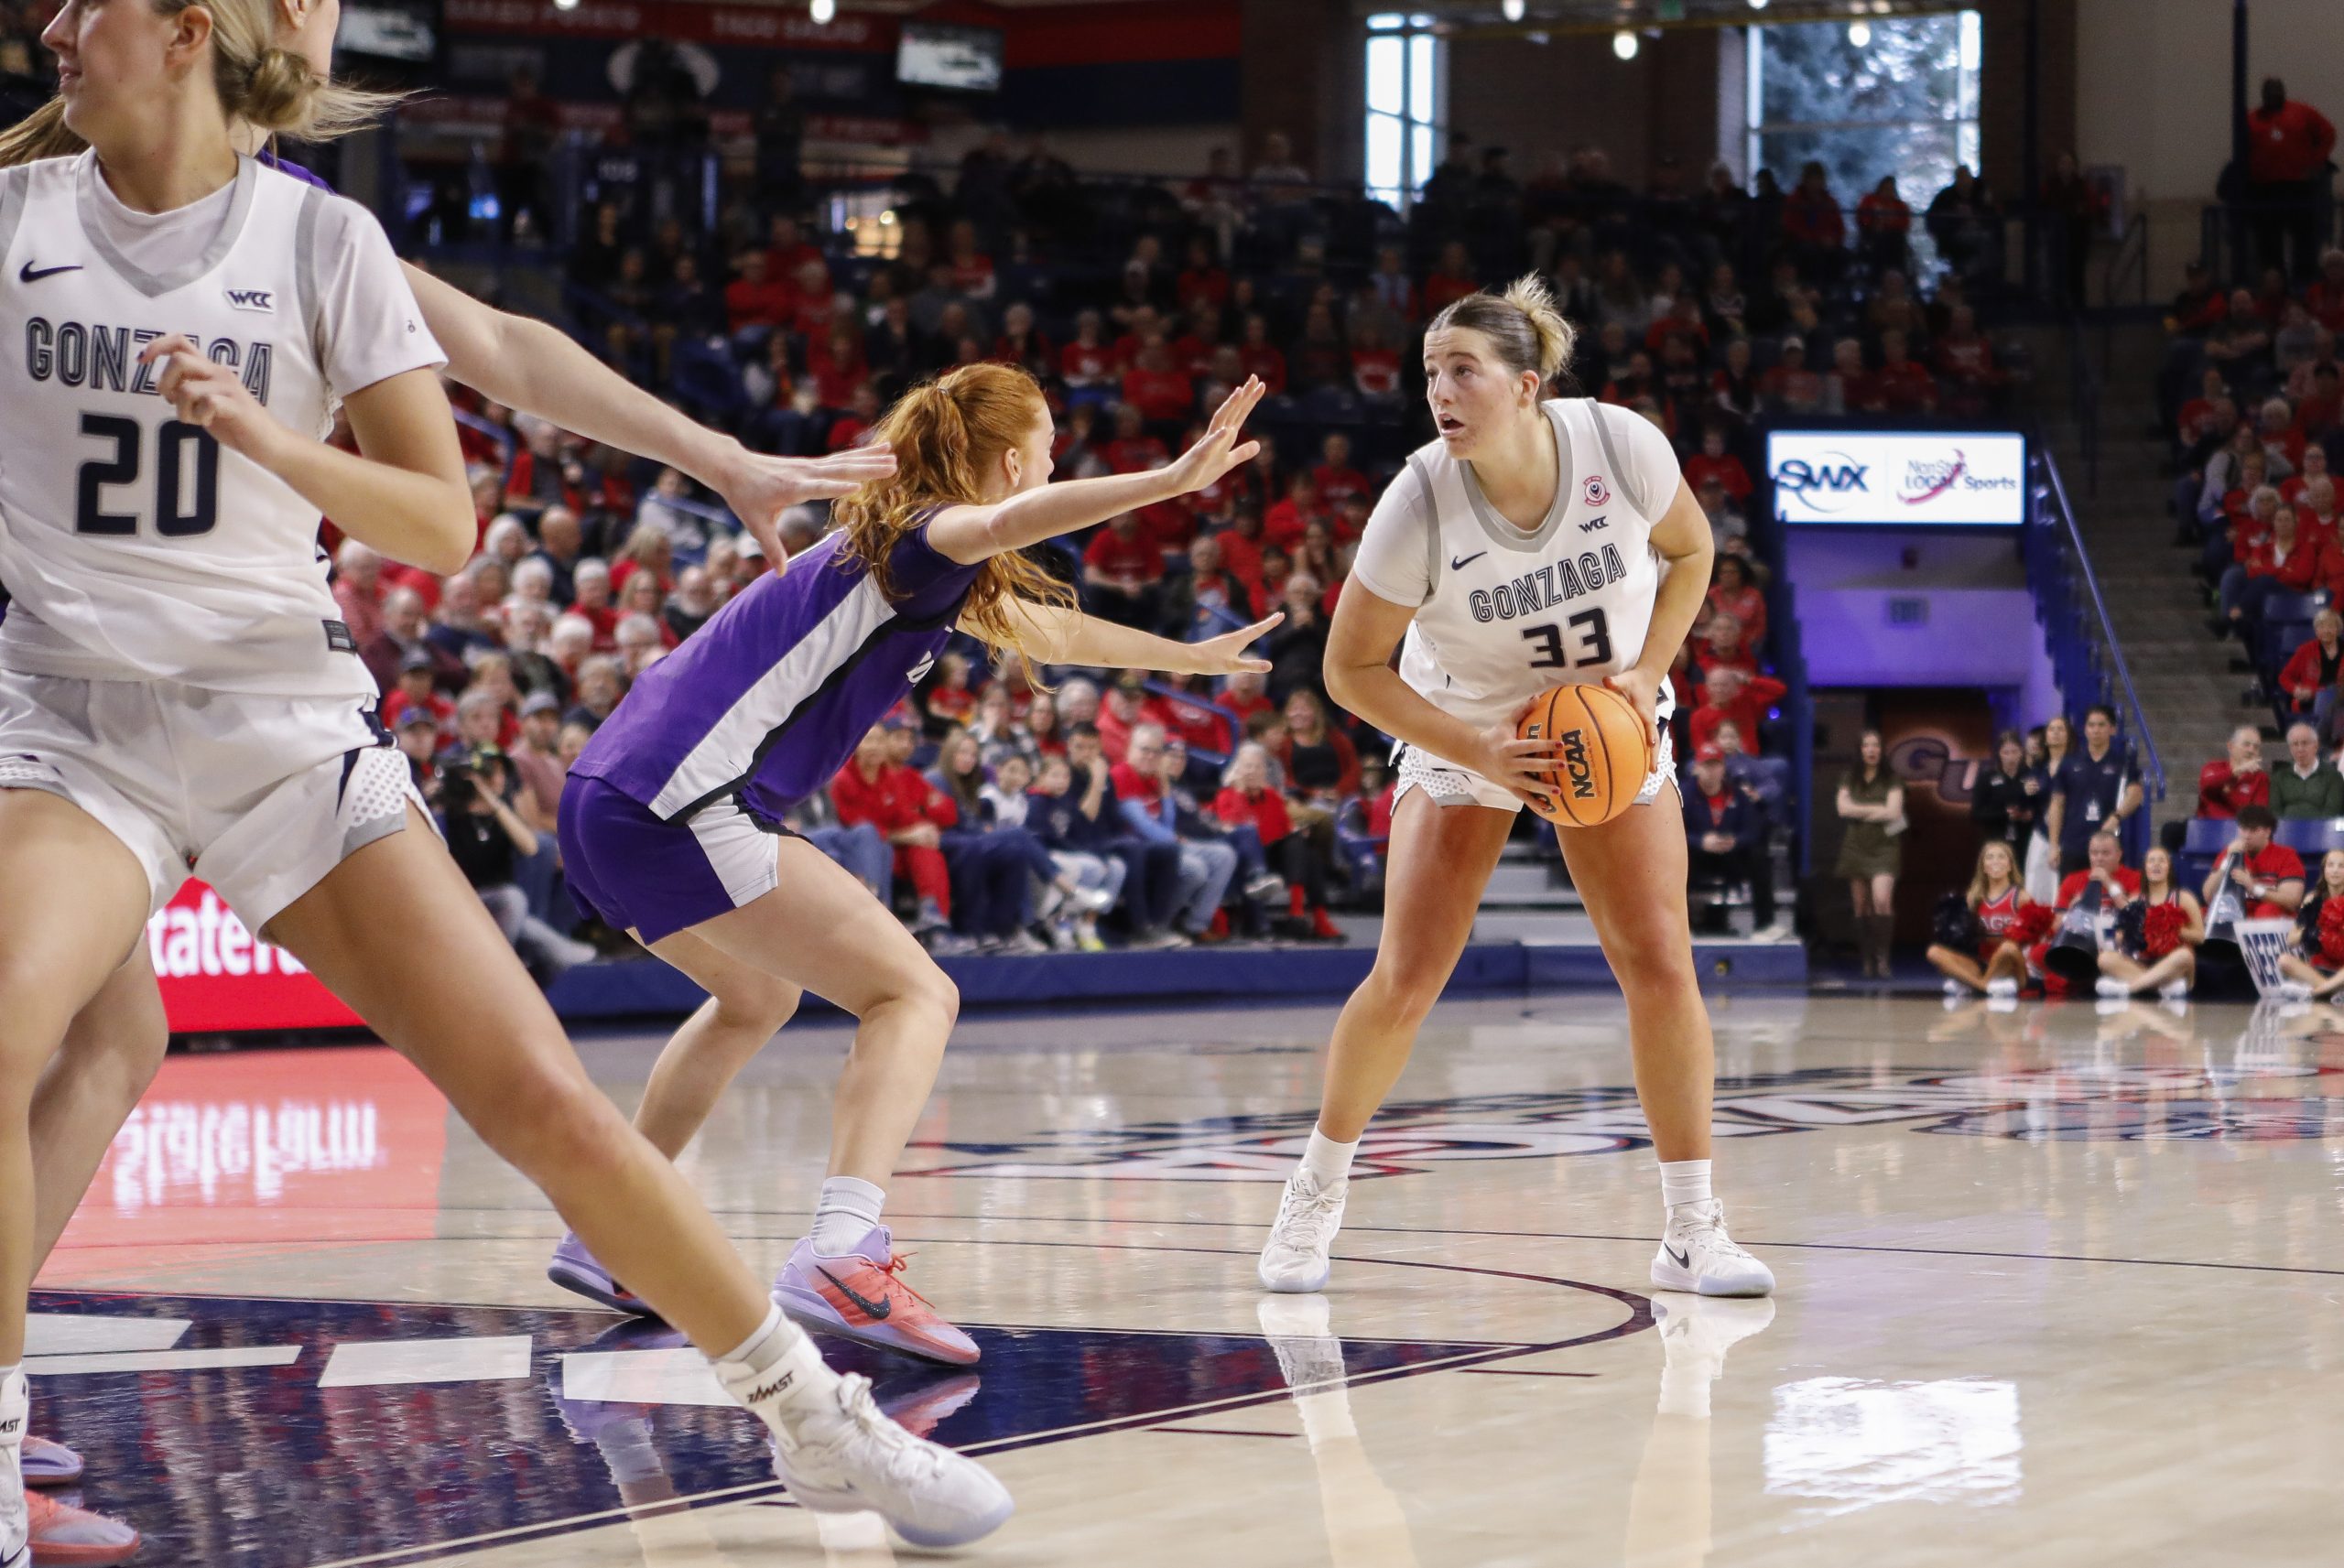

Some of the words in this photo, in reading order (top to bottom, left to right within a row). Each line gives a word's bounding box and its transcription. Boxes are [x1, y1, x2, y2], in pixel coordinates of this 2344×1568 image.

[228, 290, 272, 308] WCC
[75, 412, 220, 537] 20
[1776, 459, 1871, 493] SWX
[1964, 475, 2016, 492] Sports
[1578, 515, 1609, 534] WCC
[1470, 543, 1627, 623] GONZAGA
[1519, 605, 1614, 669] 33
[1561, 728, 1597, 800] NCAA
